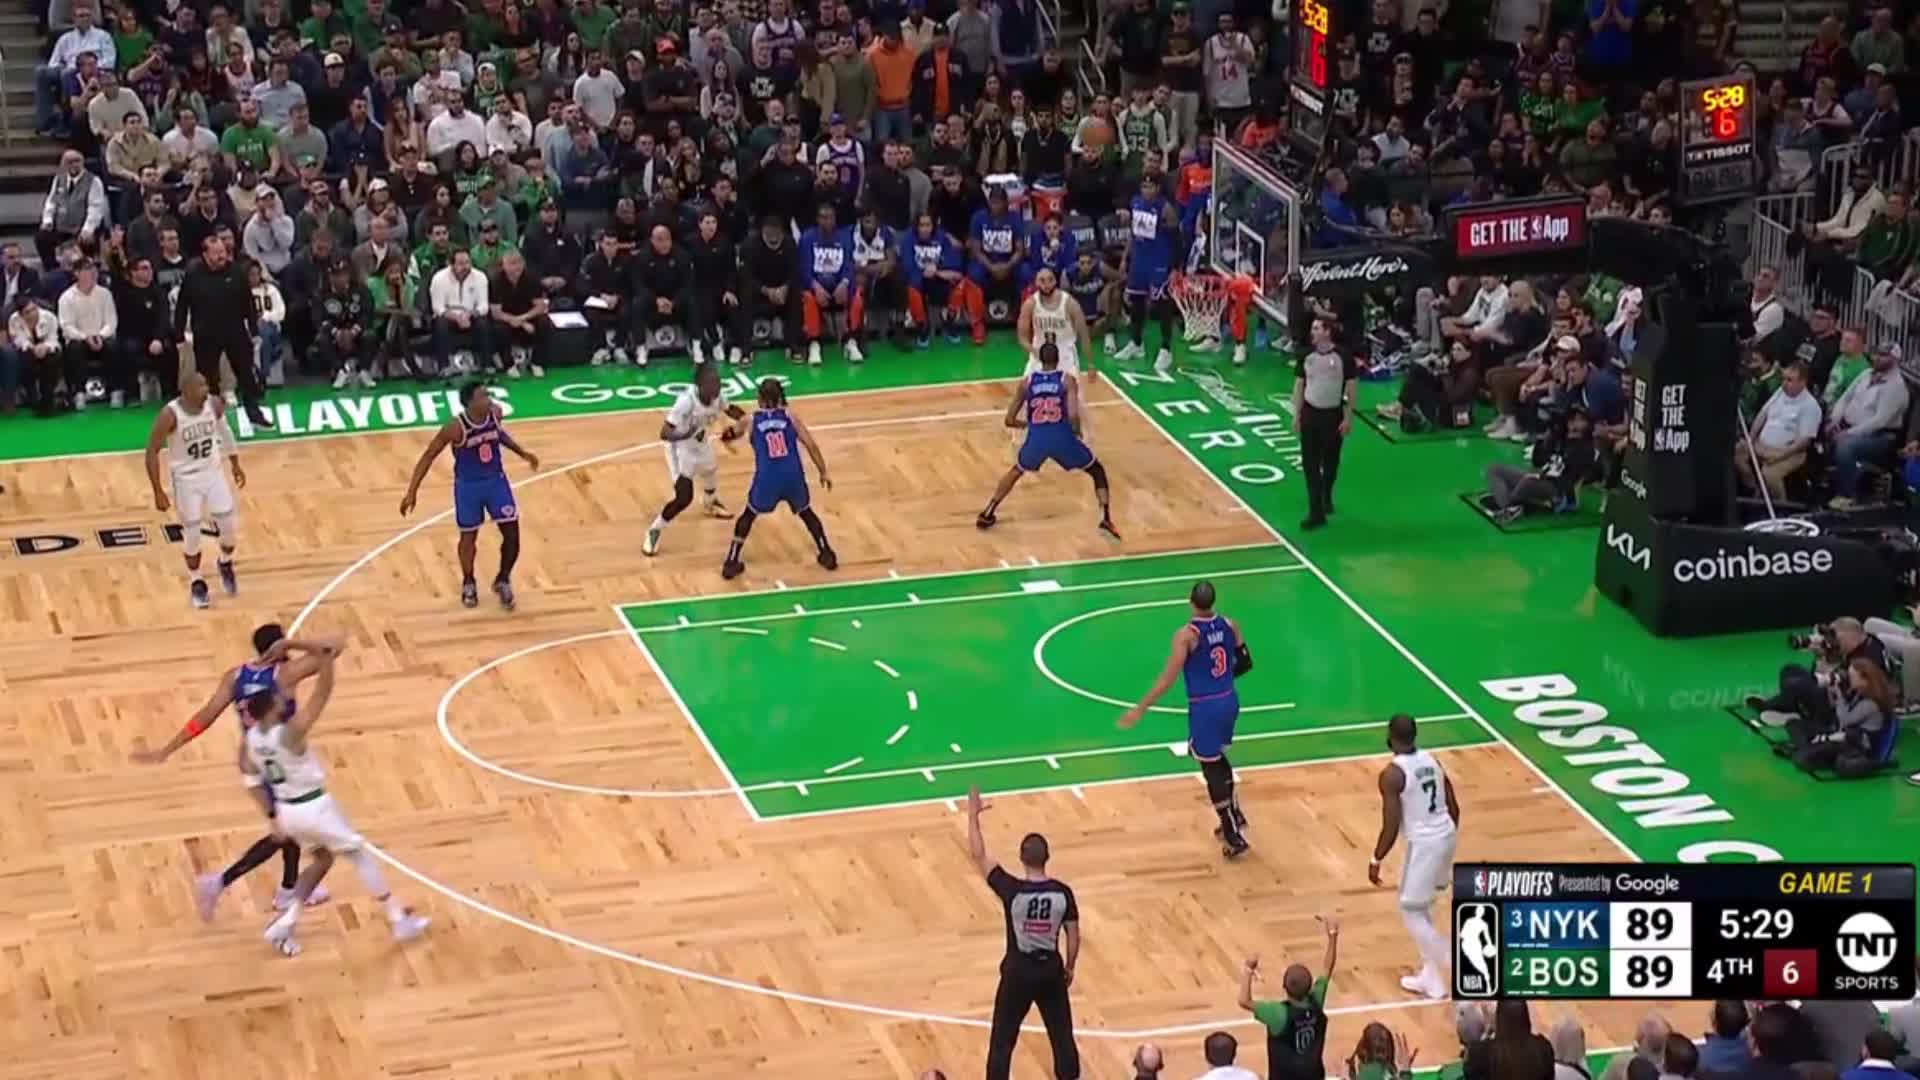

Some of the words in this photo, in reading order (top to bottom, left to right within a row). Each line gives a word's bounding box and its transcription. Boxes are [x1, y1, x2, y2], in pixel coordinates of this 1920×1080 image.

[1719, 108, 1736, 136] 6
[1470, 222, 1496, 246] GET
[1502, 218, 1527, 242] THE
[1543, 214, 1569, 241] App
[1662, 384, 1686, 406] GET
[1662, 406, 1685, 427] THE
[187, 438, 213, 460] 42
[1666, 428, 1690, 454] App
[1673, 545, 1833, 582] coinbase
[1210, 646, 1226, 678] 3
[1479, 673, 1736, 829] BOSTON
[1422, 779, 1437, 813] 7
